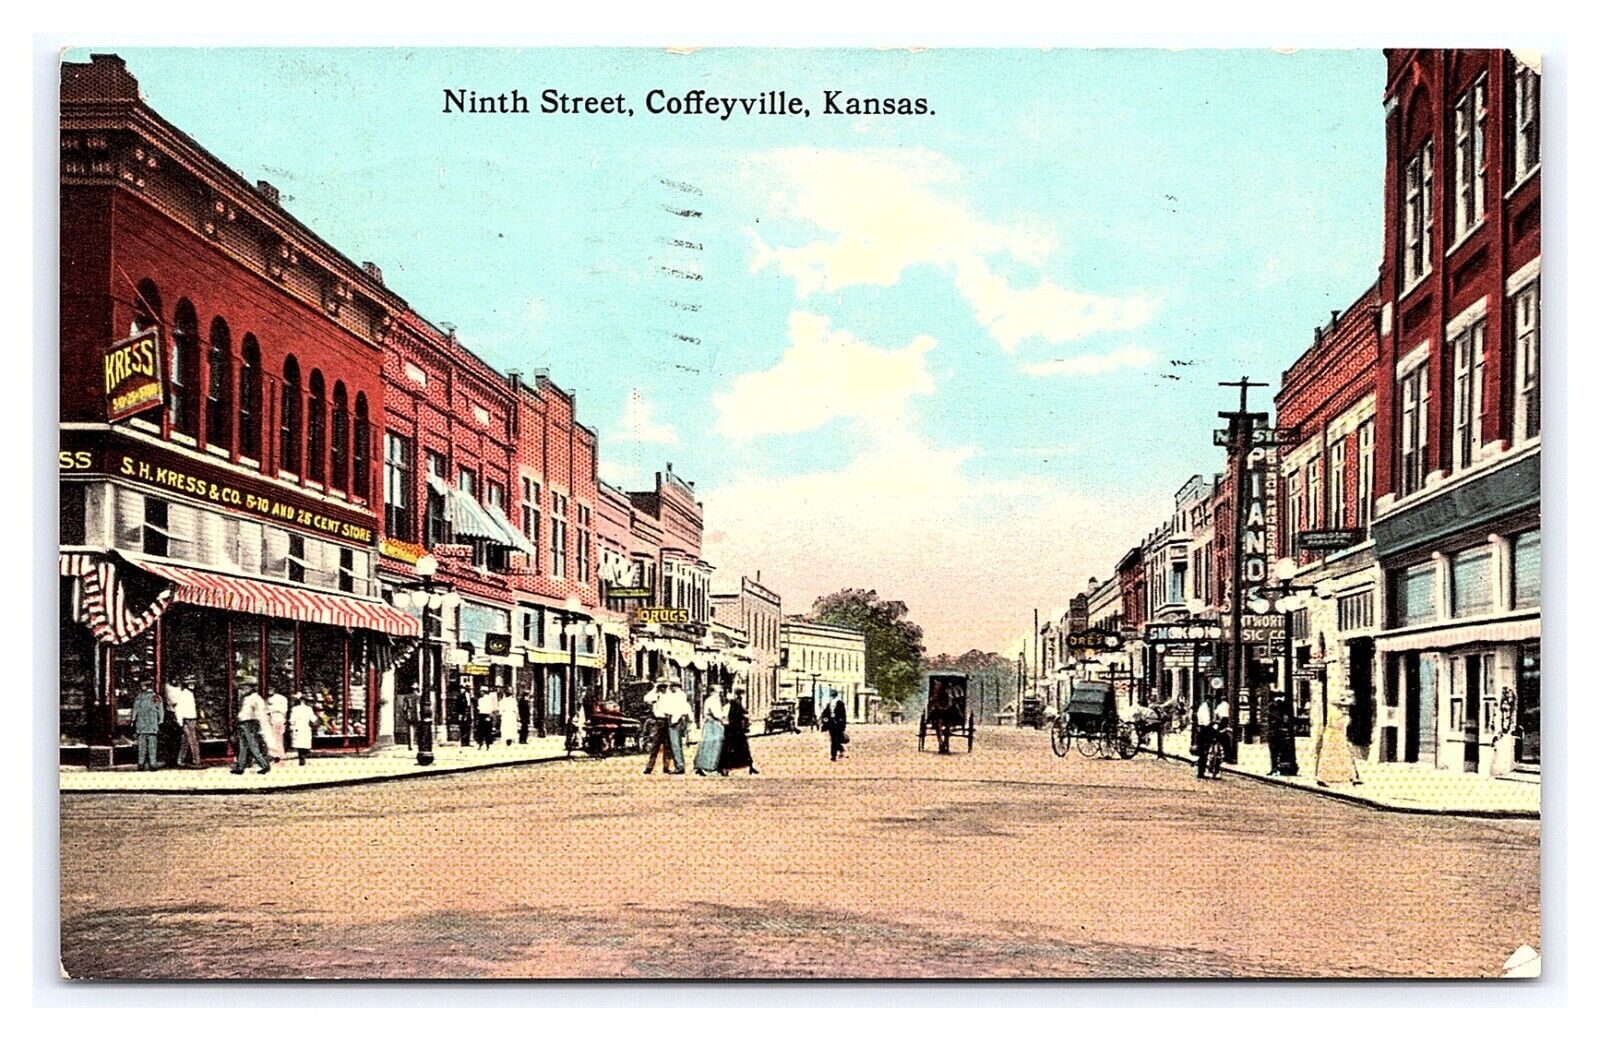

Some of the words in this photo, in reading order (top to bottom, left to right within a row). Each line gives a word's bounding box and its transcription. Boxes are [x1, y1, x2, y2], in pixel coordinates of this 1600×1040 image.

[105, 339, 154, 394] KRESS
[120, 456, 136, 476] S.
[139, 461, 154, 481] H.
[156, 467, 207, 495] KRESS
[209, 484, 220, 501] &
[221, 486, 243, 506] CO.
[271, 502, 295, 520] AND
[297, 509, 313, 526] 25
[313, 514, 341, 534] CENT
[341, 522, 372, 543] STORE
[639, 609, 688, 623] DRUGS
